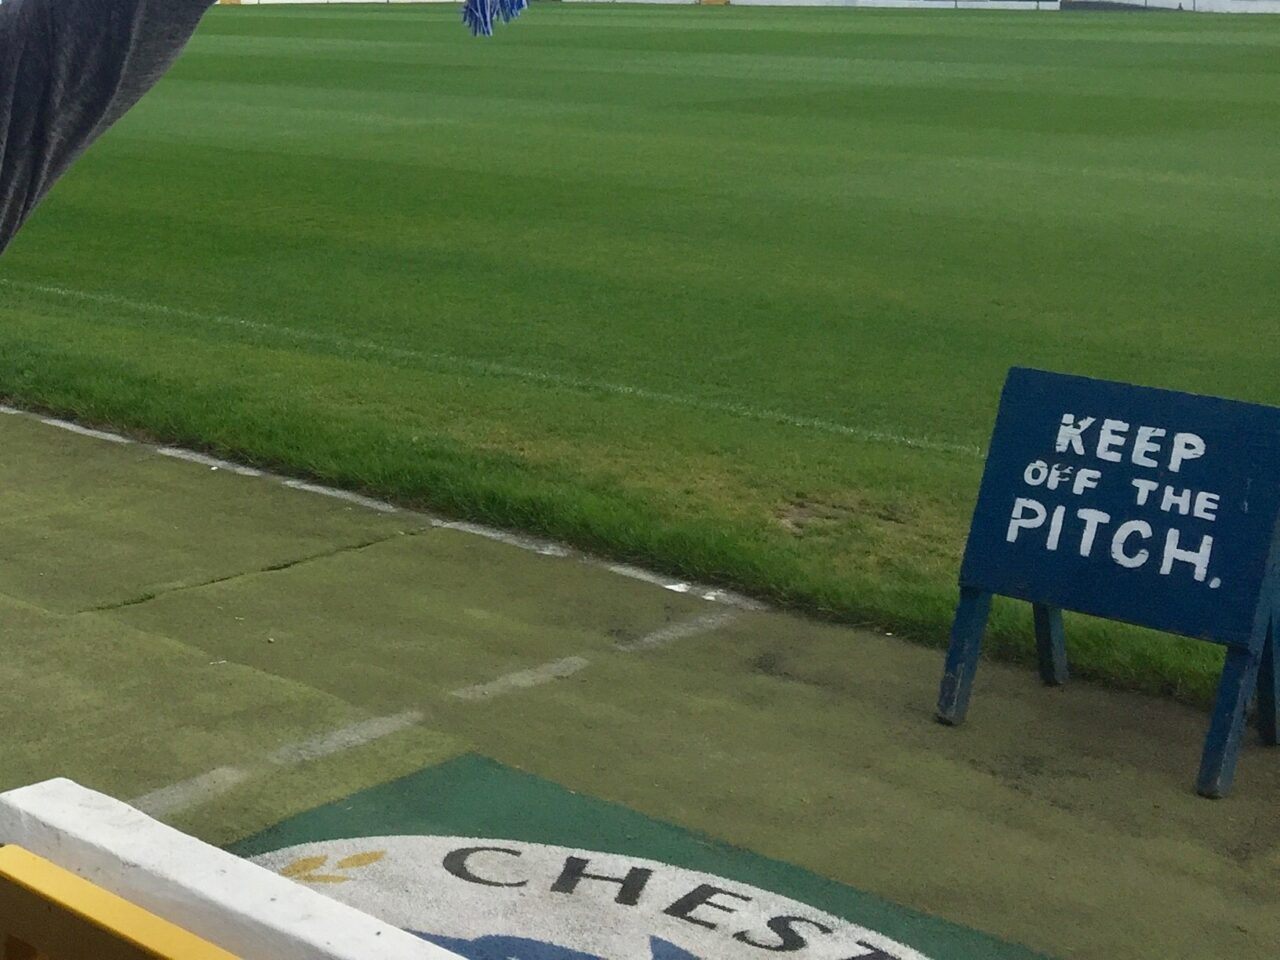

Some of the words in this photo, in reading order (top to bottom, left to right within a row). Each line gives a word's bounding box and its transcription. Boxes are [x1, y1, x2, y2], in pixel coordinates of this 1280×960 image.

[1055, 413, 1207, 473] KEEP
[1023, 459, 1102, 495] OFF
[1131, 478, 1220, 521] THE
[1005, 496, 1222, 589] PITCH.
